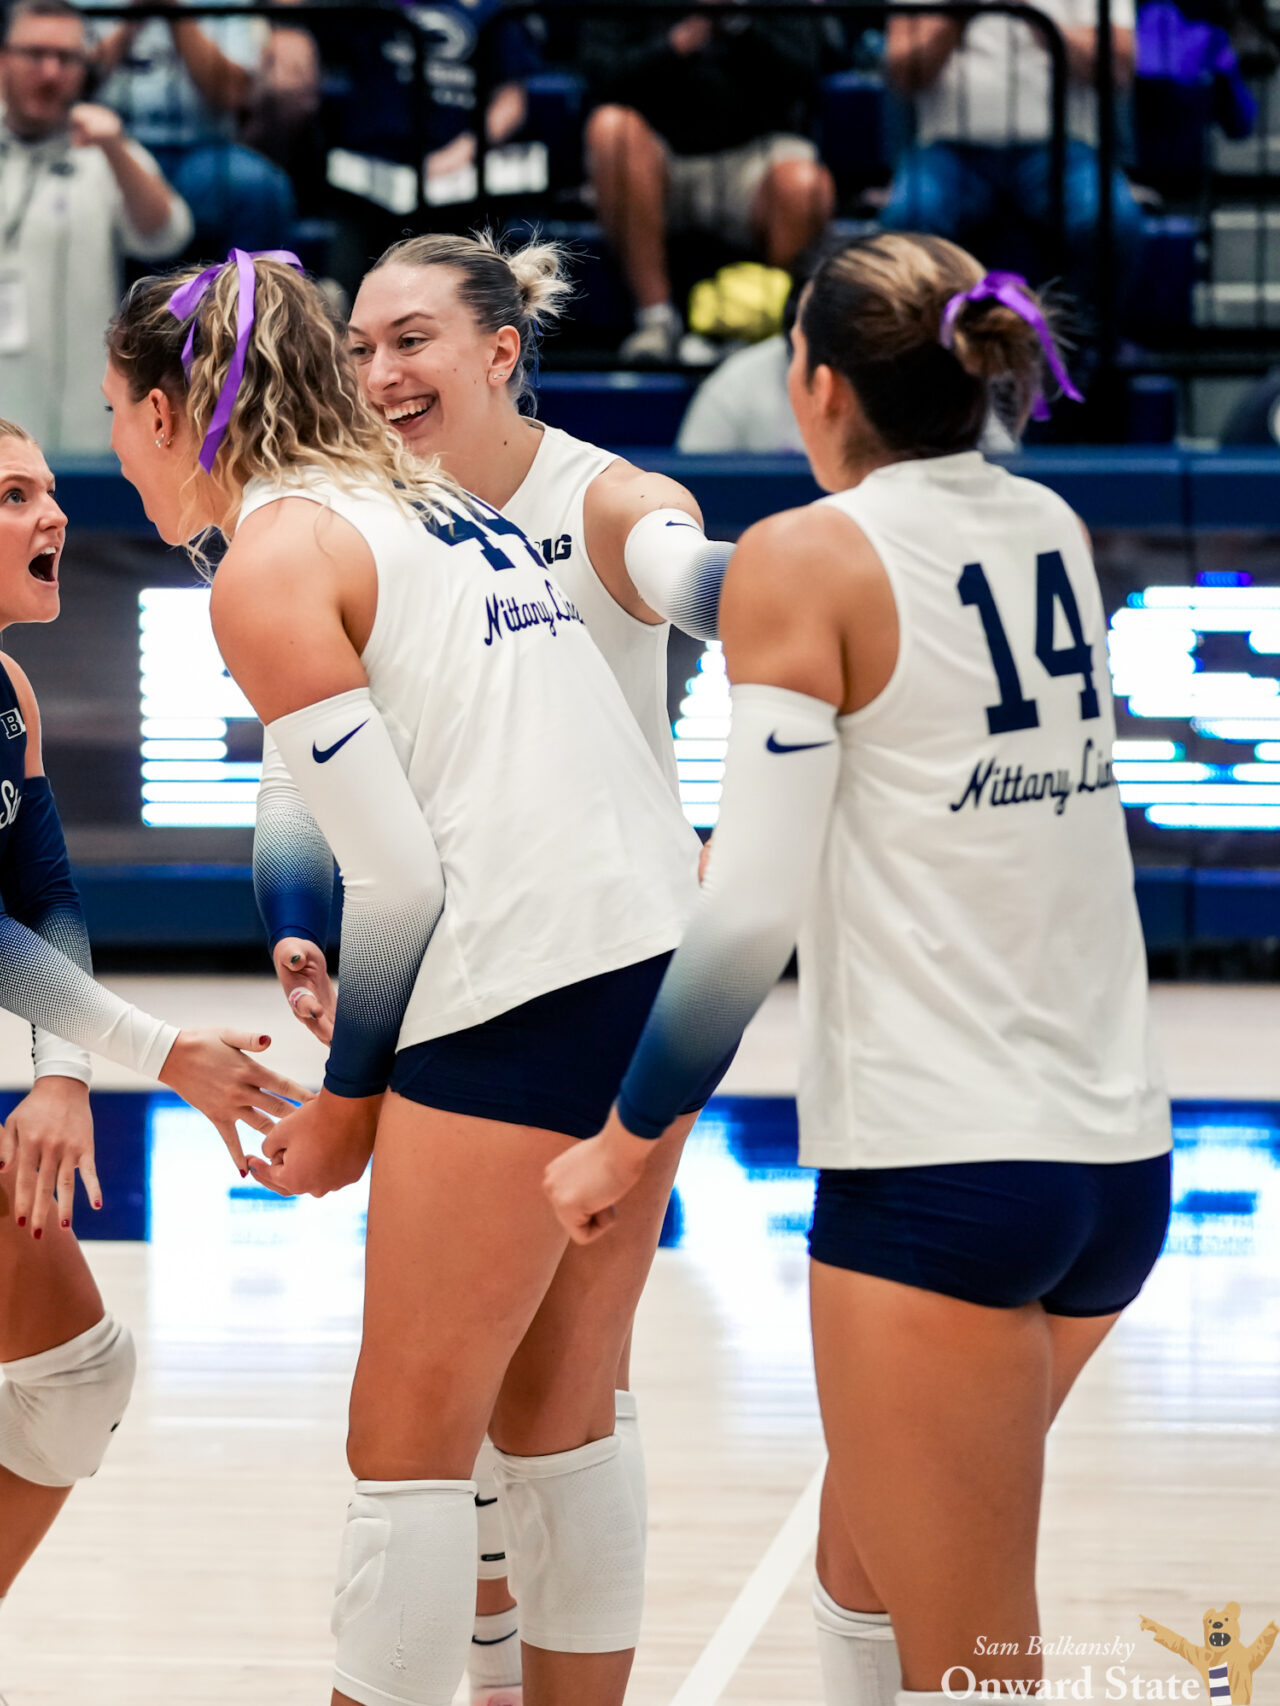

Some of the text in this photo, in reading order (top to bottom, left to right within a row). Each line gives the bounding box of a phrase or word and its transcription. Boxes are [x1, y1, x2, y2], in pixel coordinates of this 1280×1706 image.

[483, 591, 557, 647] Nittany
[956, 550, 1101, 736] 14
[949, 756, 1070, 816] Nittany
